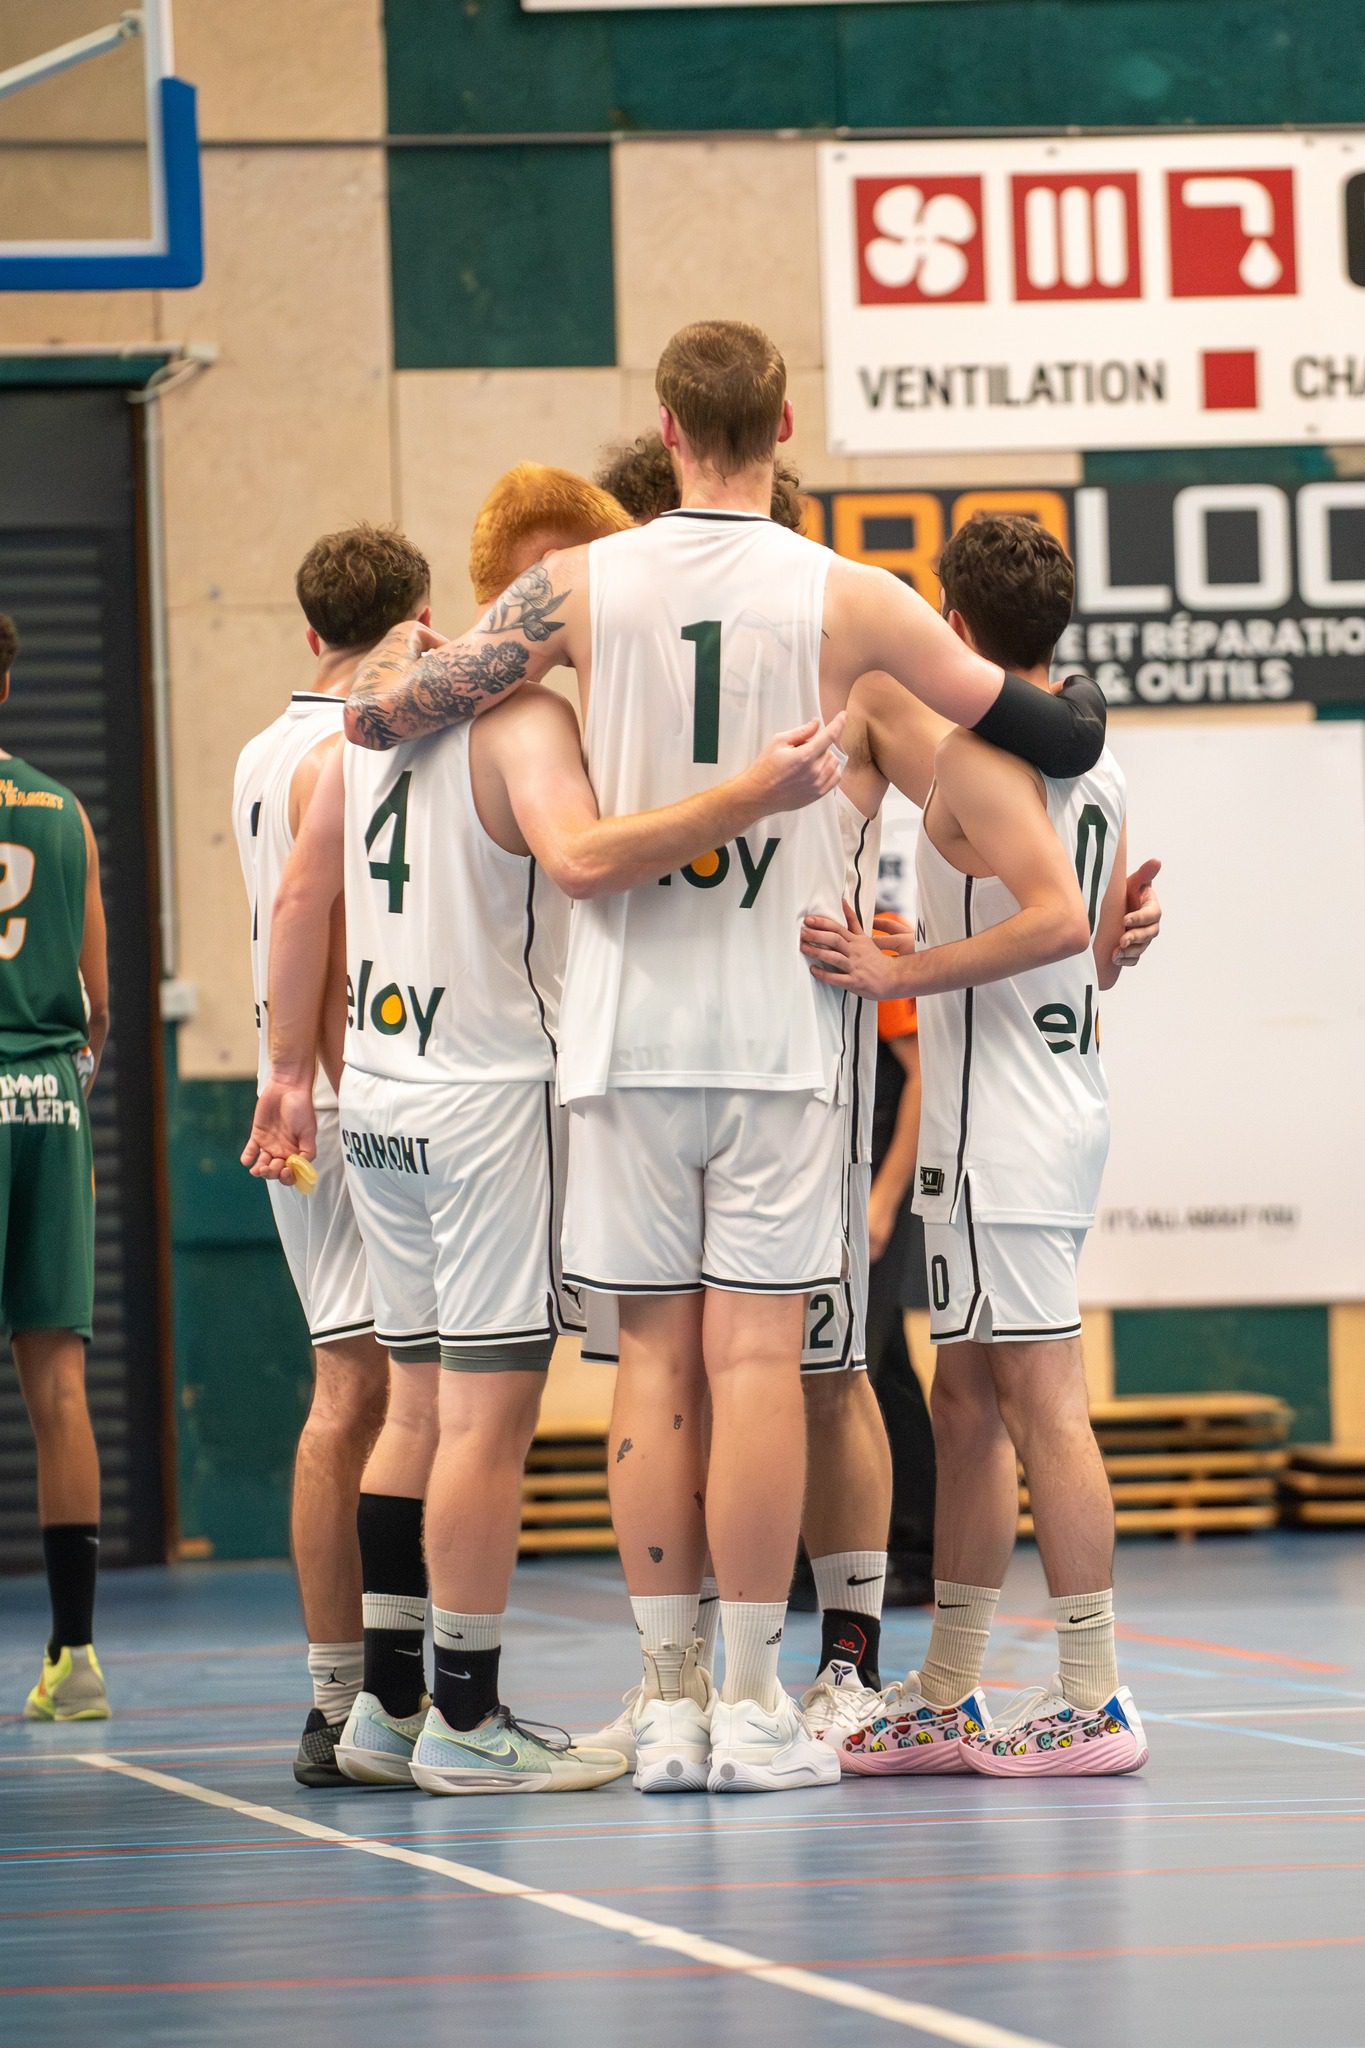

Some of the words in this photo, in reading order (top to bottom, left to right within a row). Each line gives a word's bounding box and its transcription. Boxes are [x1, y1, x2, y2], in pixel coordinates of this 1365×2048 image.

[859, 360, 1166, 408] VENTILATION
[1087, 622, 1139, 662] ET
[681, 620, 722, 764] 1
[1135, 658, 1294, 701] OUTILS
[365, 770, 413, 914] 4
[1033, 984, 1100, 1055] el
[931, 1254, 950, 1311] 0
[809, 1293, 834, 1349] 2
